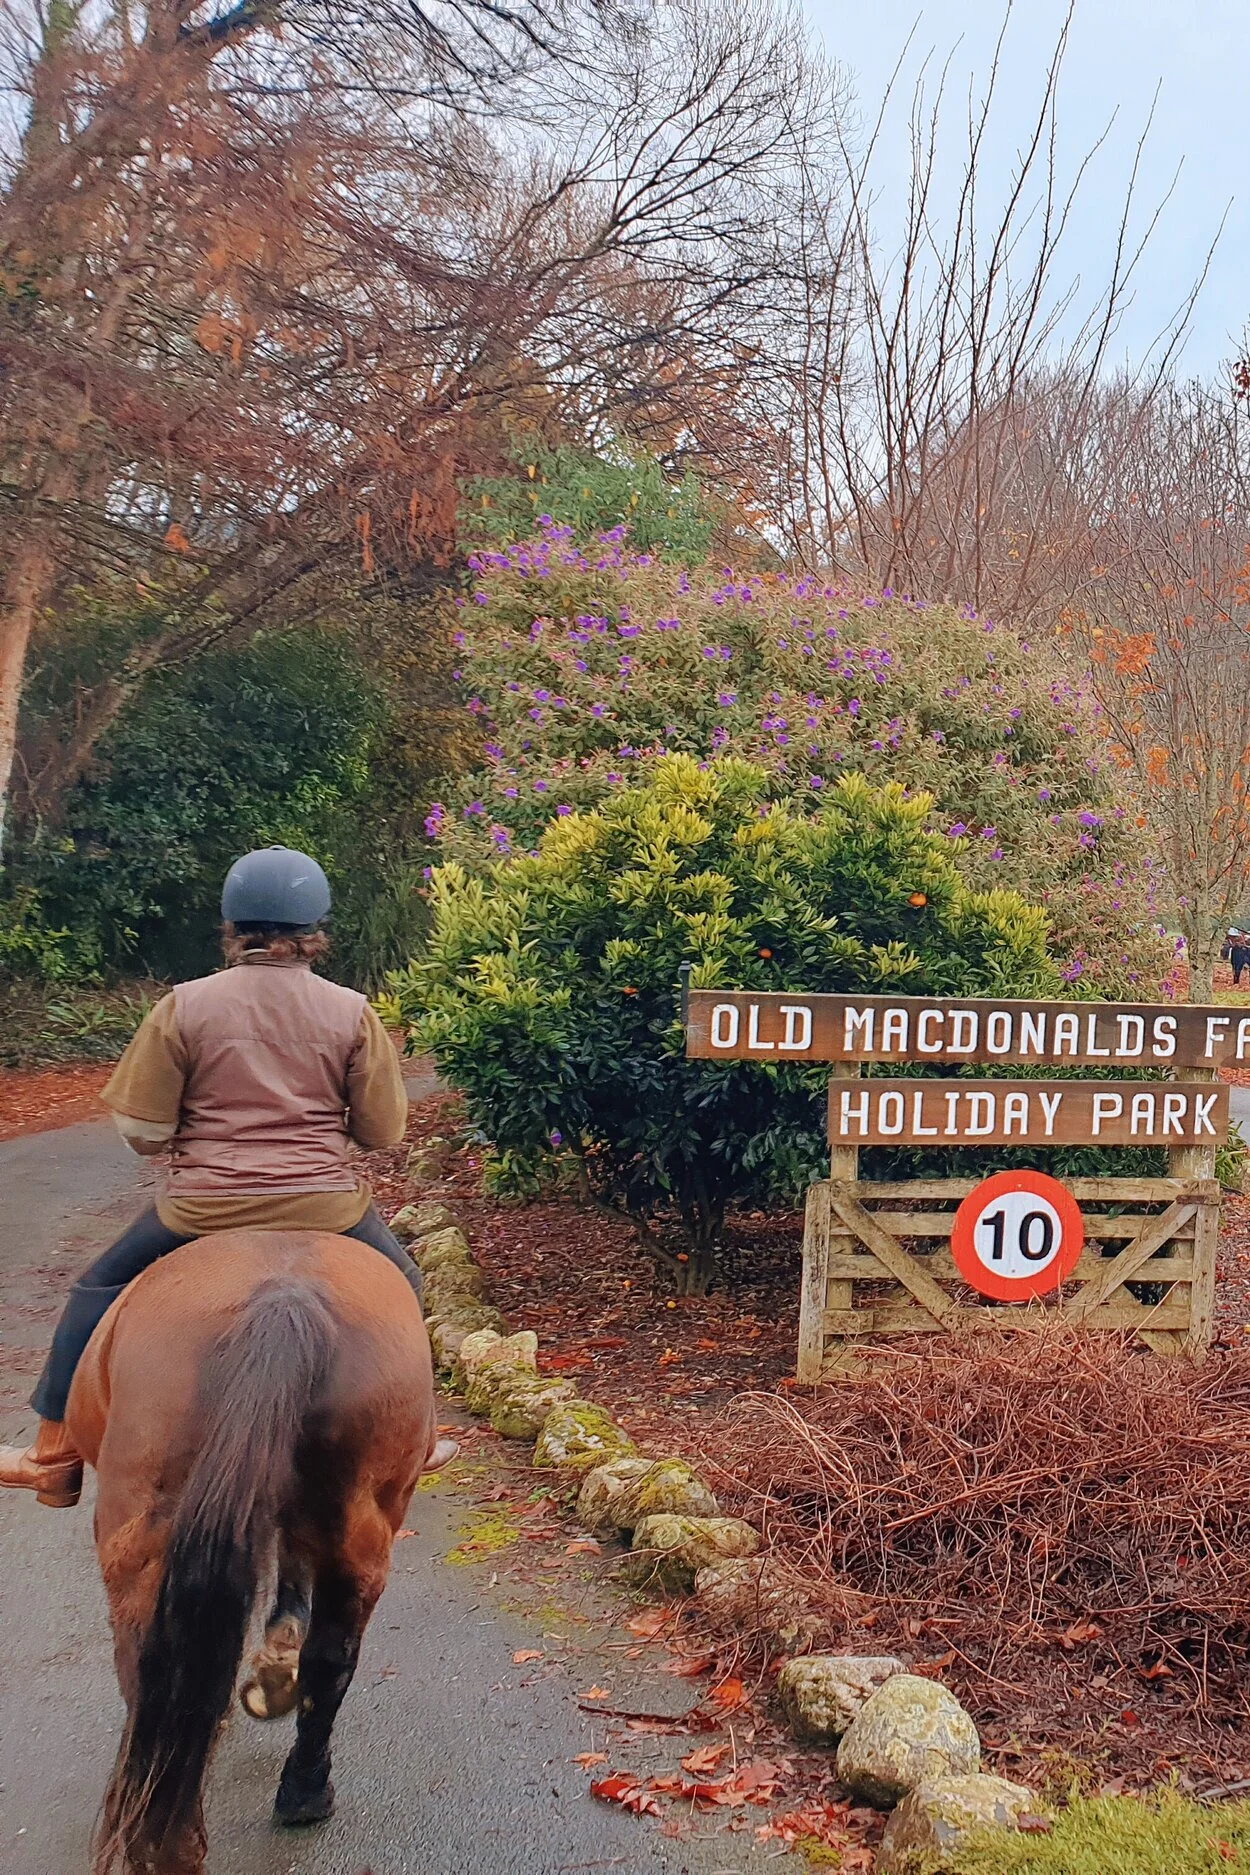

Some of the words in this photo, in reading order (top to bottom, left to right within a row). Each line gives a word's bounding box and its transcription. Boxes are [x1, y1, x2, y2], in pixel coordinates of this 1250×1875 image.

[710, 1003, 813, 1051] OLD
[842, 1006, 1177, 1057] MACDONALDS
[839, 1090, 1062, 1137] HOLIDAY
[1091, 1093, 1218, 1136] PARK
[981, 1209, 1054, 1262] 10
